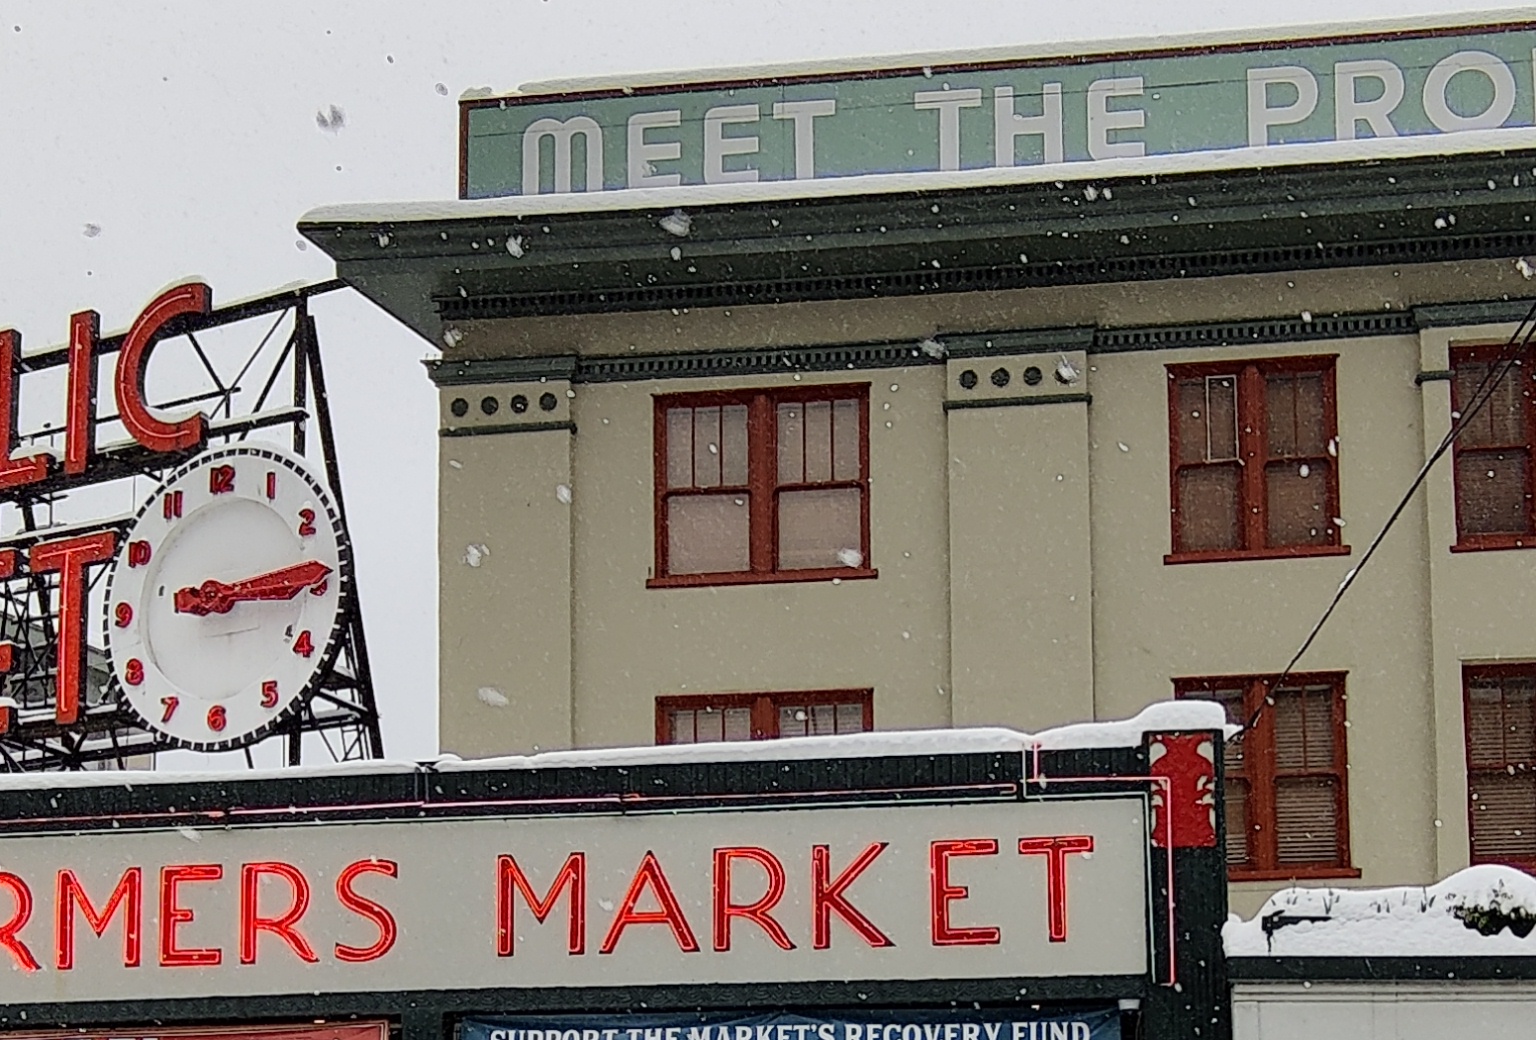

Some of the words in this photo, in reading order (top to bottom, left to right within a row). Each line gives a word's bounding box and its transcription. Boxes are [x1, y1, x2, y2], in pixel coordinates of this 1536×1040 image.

[521, 99, 836, 195] MEET
[915, 75, 1145, 172] THE
[210, 465, 235, 494] 12
[267, 472, 276, 500] 1
[163, 490, 183, 519] 11
[299, 508, 316, 536] 2
[128, 540, 151, 567] 10
[115, 602, 132, 628] 9
[293, 630, 314, 657] 4
[125, 658, 144, 686] 8
[261, 680, 278, 708] 5
[161, 696, 179, 723] 7
[208, 705, 226, 731] 6
[495, 834, 1097, 957] MARKET
